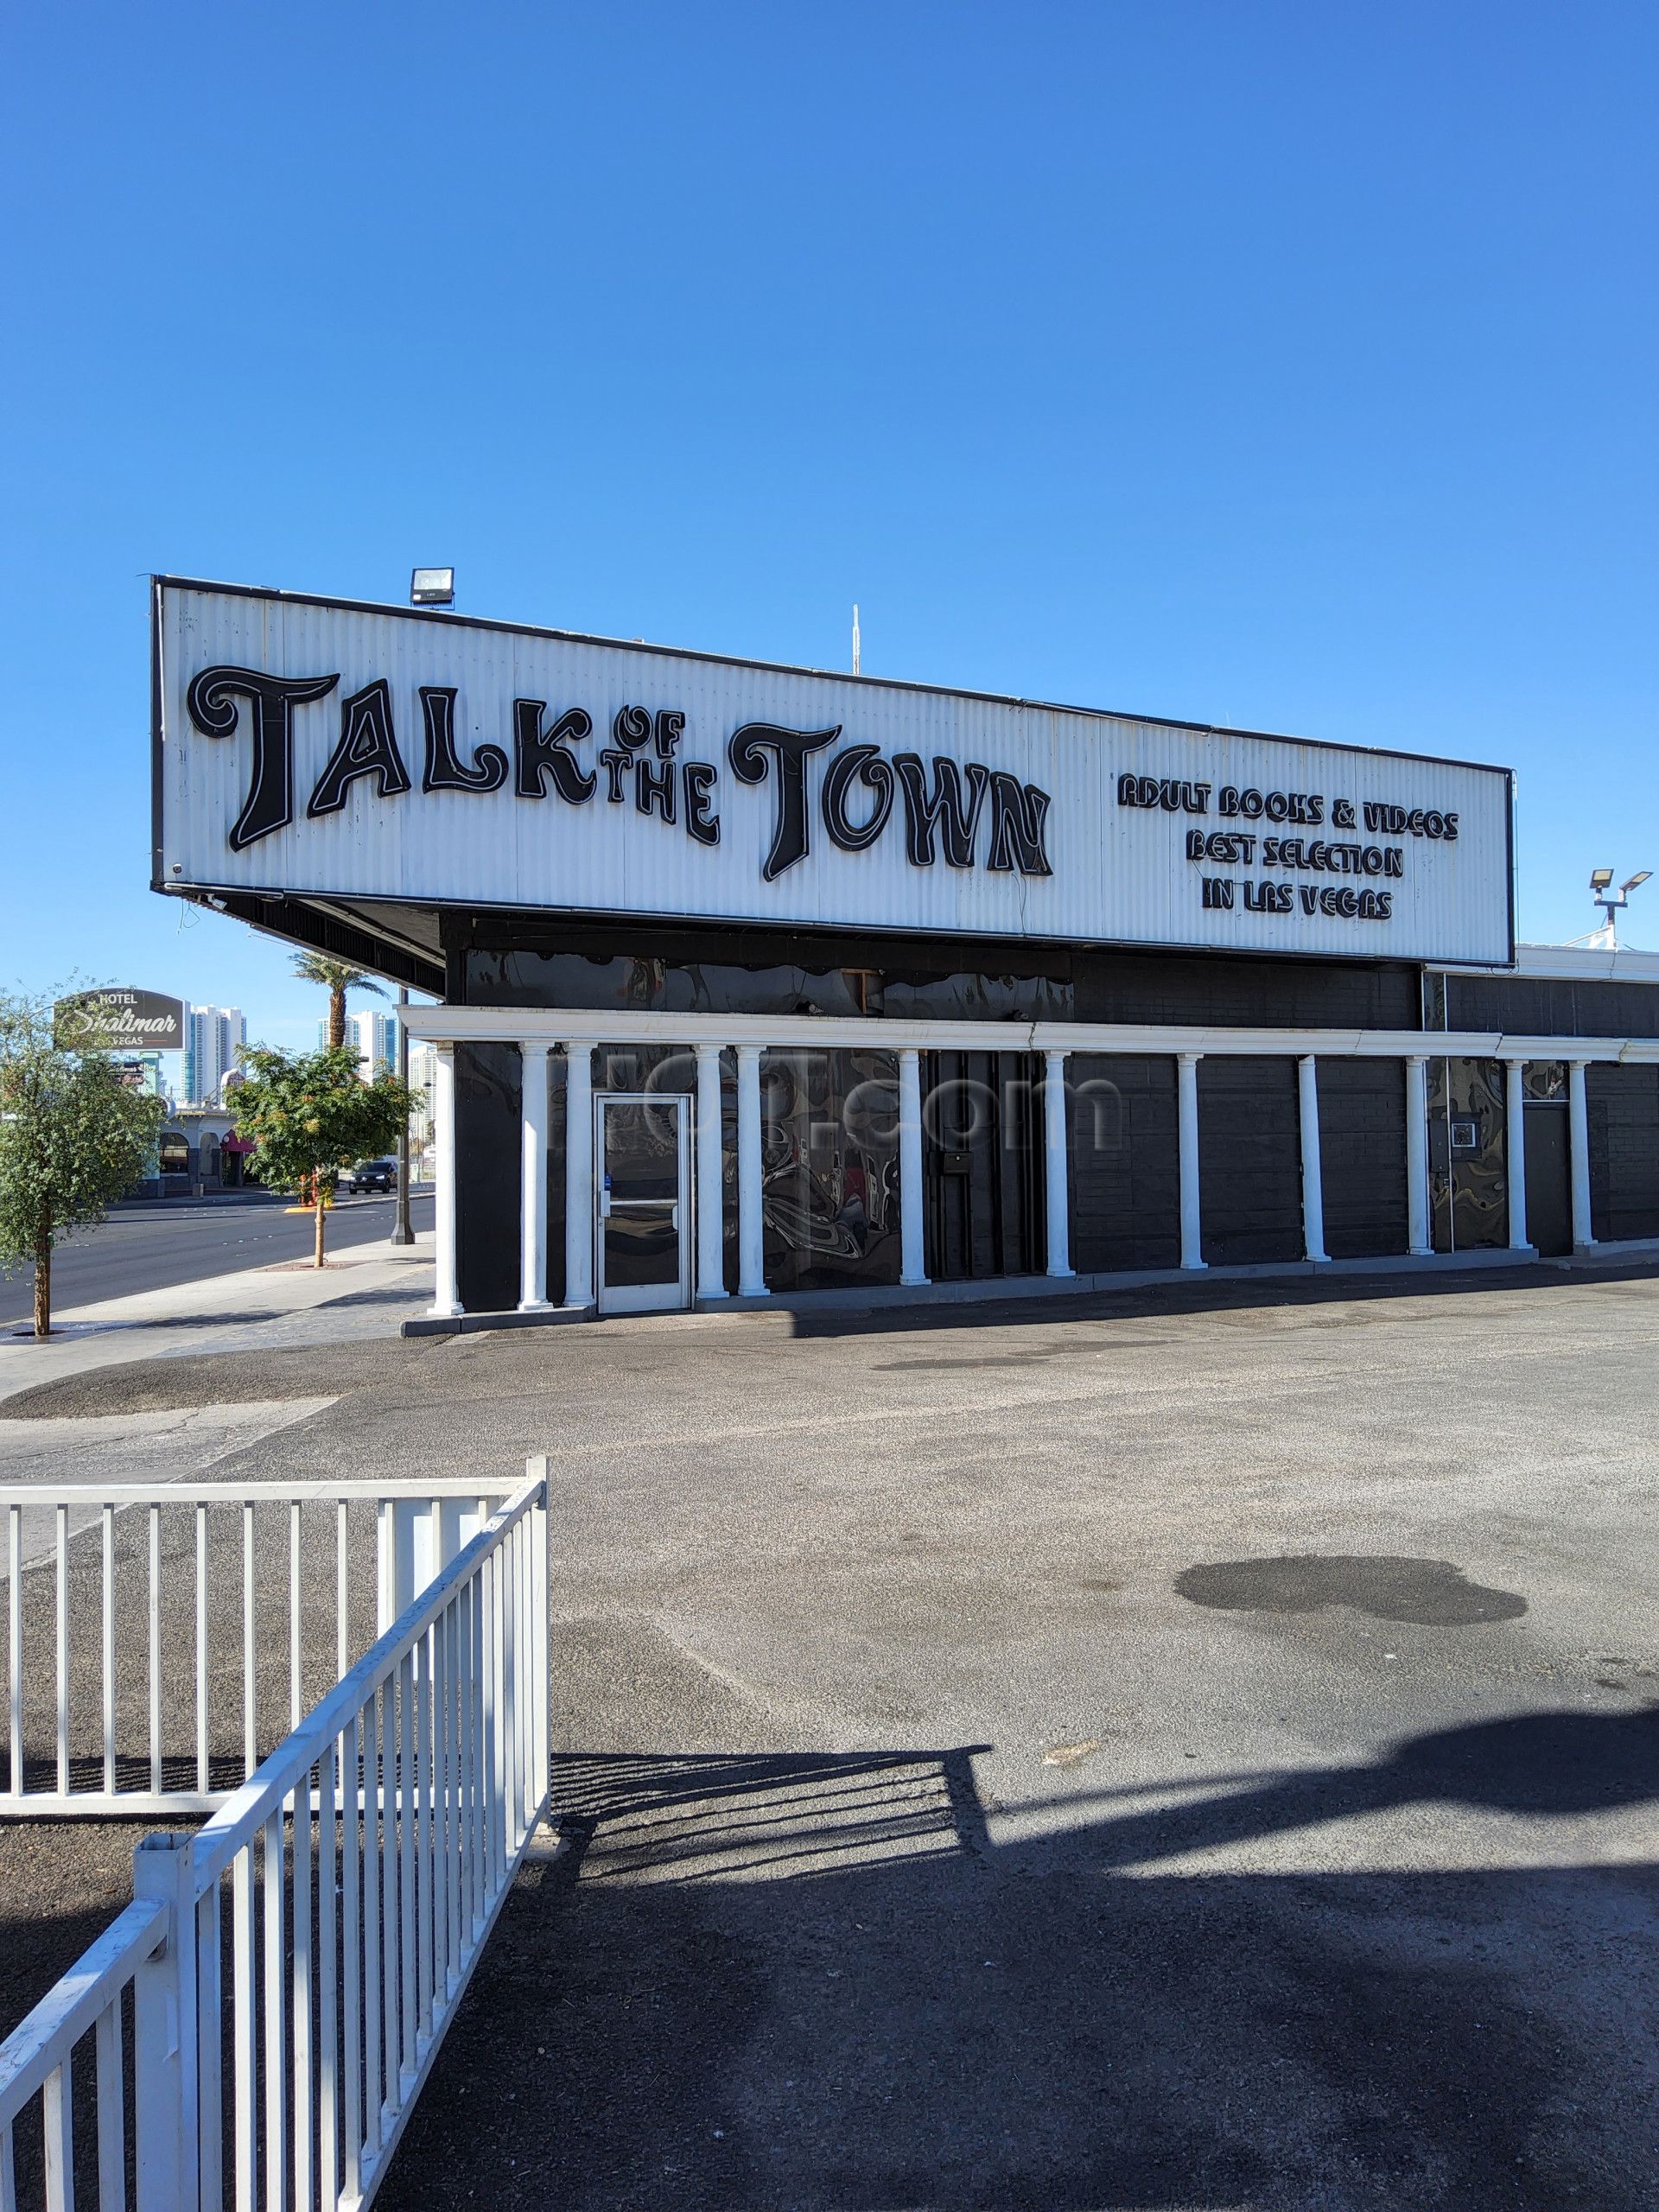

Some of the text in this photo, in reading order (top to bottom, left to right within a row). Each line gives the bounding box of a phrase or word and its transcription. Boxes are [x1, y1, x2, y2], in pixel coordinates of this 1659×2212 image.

[187, 664, 1053, 882] TALK OF THE TOWN
[1117, 772, 1460, 840] ADULT BOOKS & VIDEOS
[1185, 829, 1403, 878] BEST SELECTION
[1202, 878, 1394, 919] IN LAS VEGAS
[99, 994, 137, 1004] HOTEL
